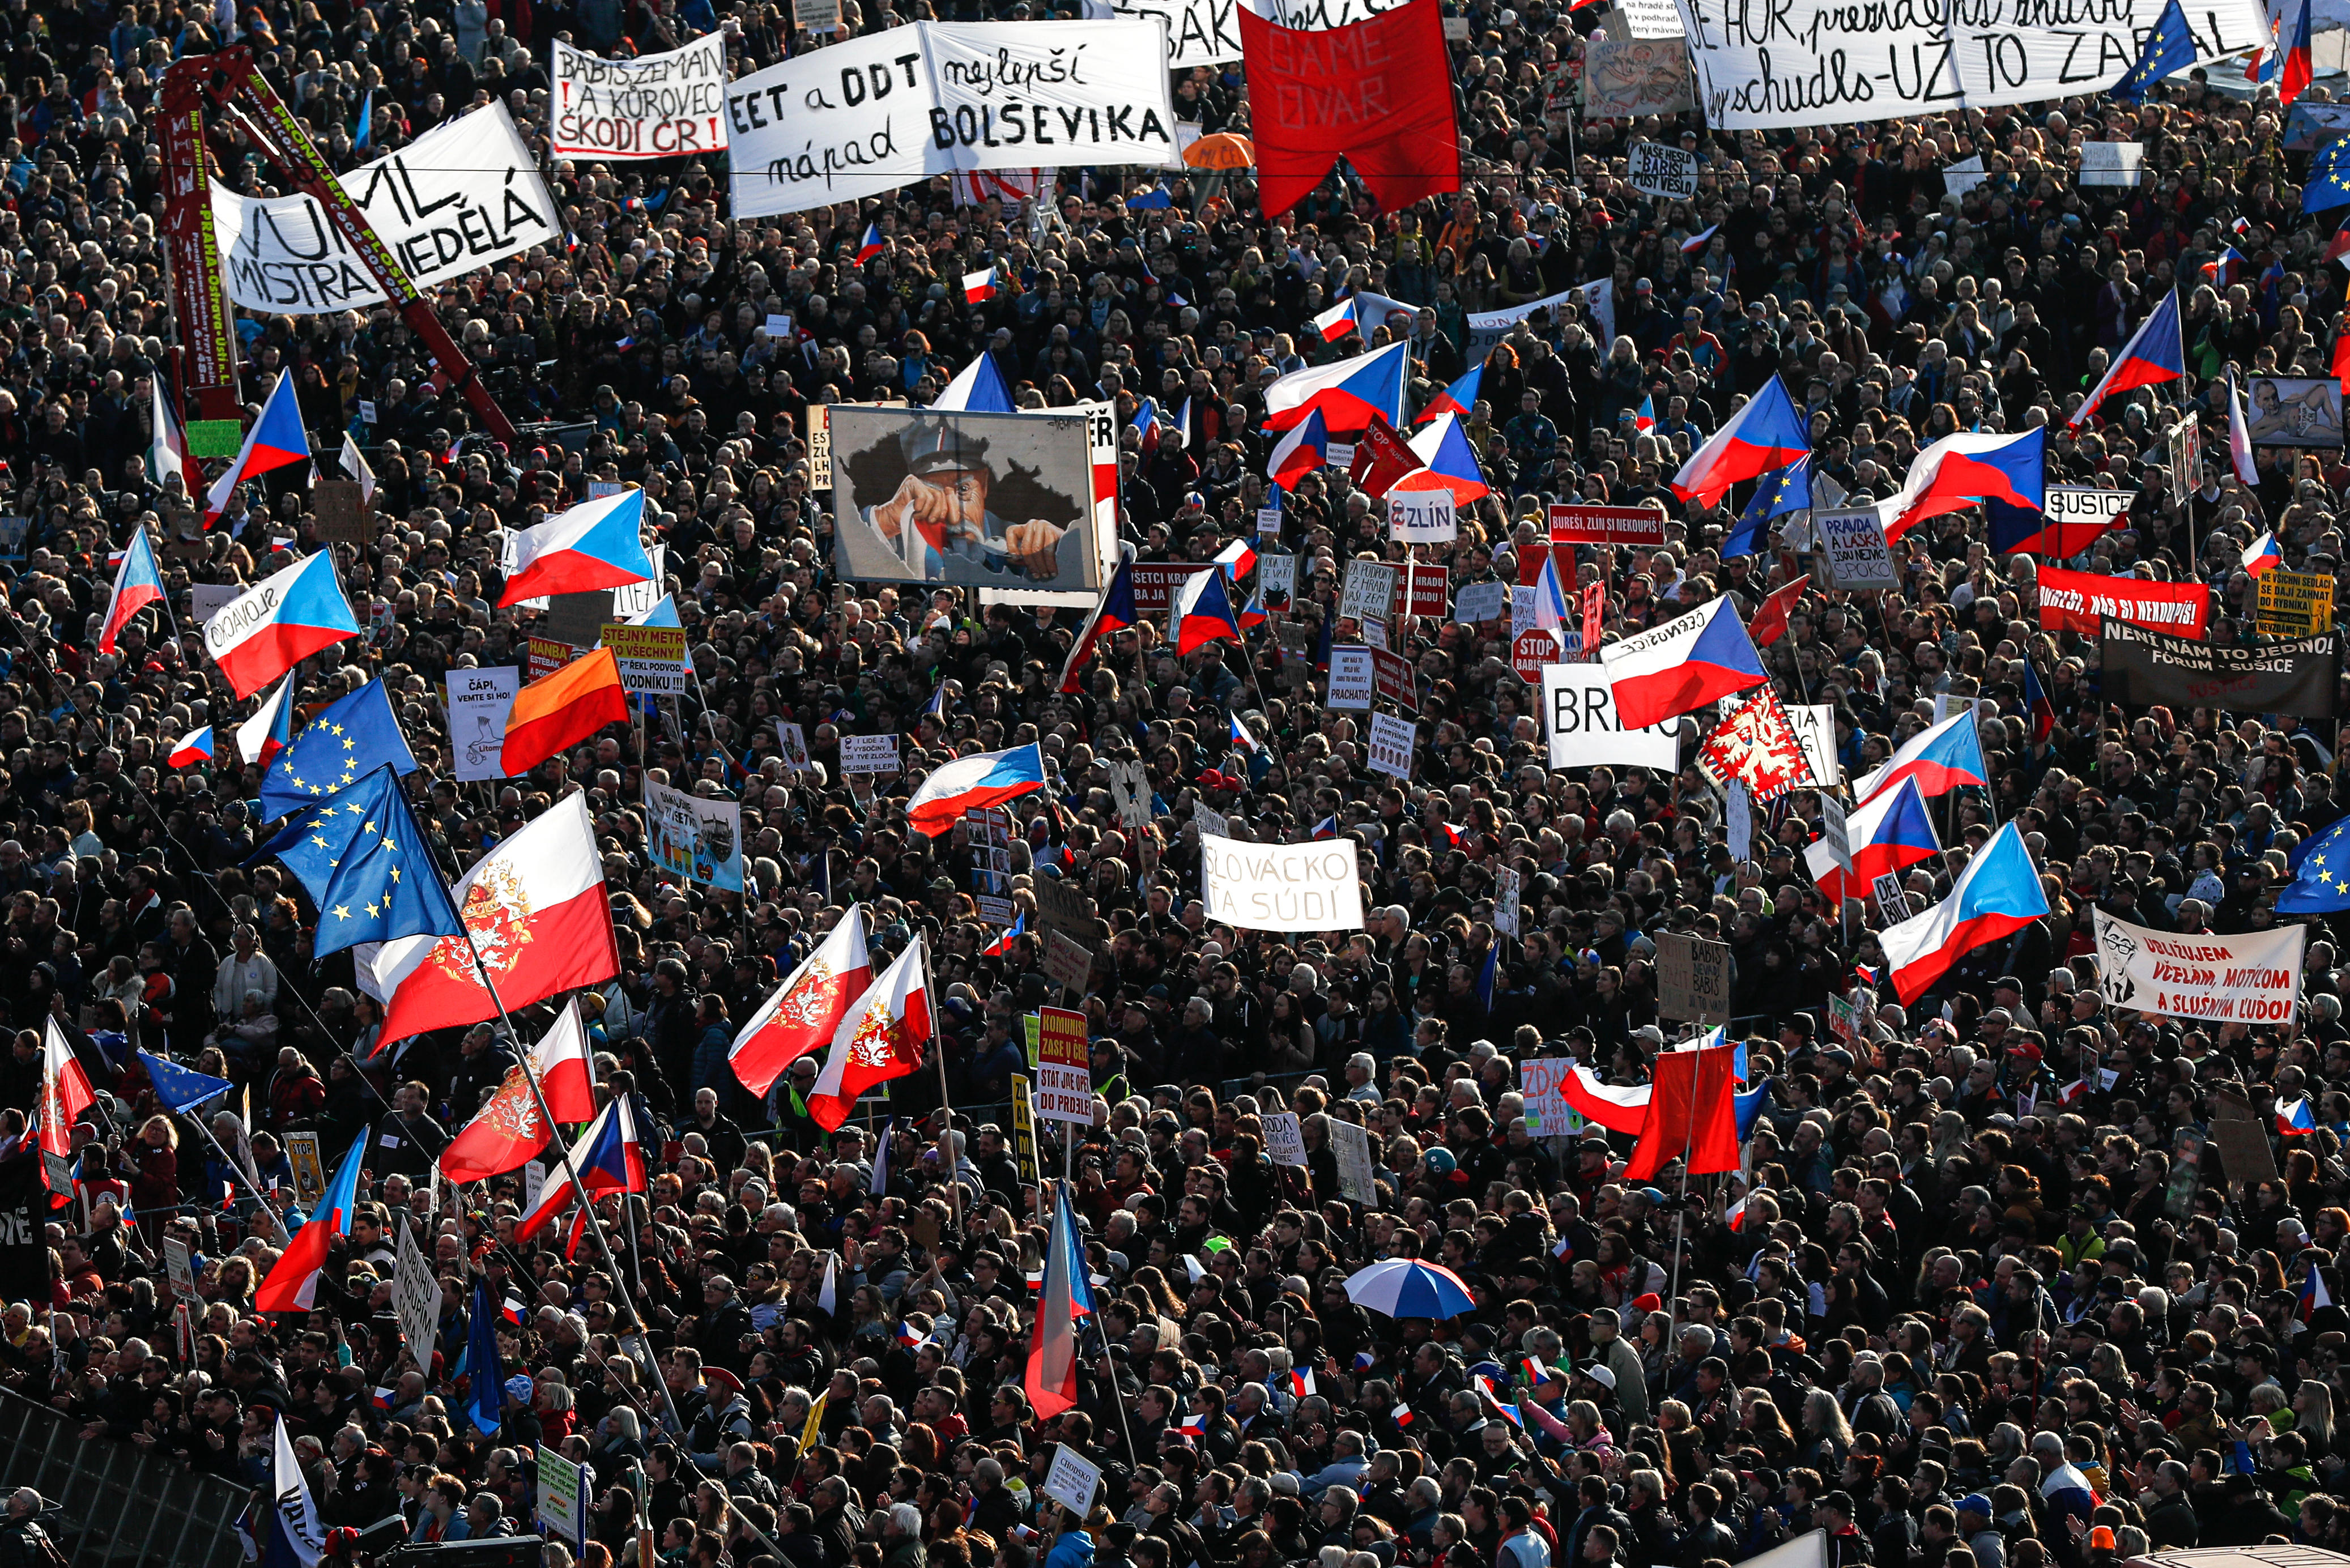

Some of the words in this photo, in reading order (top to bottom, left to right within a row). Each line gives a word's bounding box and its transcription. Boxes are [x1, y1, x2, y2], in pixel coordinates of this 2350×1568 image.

[1641, 12, 1679, 24] podhradí
[944, 42, 1088, 95] nejlepší
[1973, 33, 2028, 93] TO
[577, 90, 599, 113] A
[611, 81, 723, 119] KŮROVEC
[727, 83, 788, 134] EET
[804, 88, 836, 110] a
[841, 52, 921, 107] DDT
[929, 95, 1171, 150] BOLŠEVIKA
[768, 114, 902, 191] nápad
[1639, 144, 1663, 157] NAŠE
[1666, 148, 1691, 164] HESLO
[1661, 178, 1691, 195] VESLO
[229, 256, 377, 308] MISTRA
[1368, 424, 1389, 446] STOP
[1407, 501, 1451, 528] ZLÍN
[1552, 513, 1585, 531] BUREŠI,
[1587, 514, 1605, 530] ZLÍN
[1607, 518, 1615, 531] SI
[1616, 517, 1657, 533] NEKOUPÍŠ
[1826, 518, 1874, 535] PRAVDA
[1832, 536, 1841, 549] A
[1844, 531, 1883, 548] LÁSKA
[1262, 557, 1278, 568] VODA
[1283, 557, 1293, 568] UŽ
[1834, 551, 1853, 562] JSOU
[1855, 547, 1886, 561] NEJVÍC
[1131, 570, 1164, 584] ŠETCI
[1262, 569, 1270, 578] SE
[1348, 562, 1358, 576] ZA
[1360, 566, 1394, 579] PODPORY
[1834, 562, 1891, 580] SPOKO
[1350, 576, 1359, 589] Z
[1361, 578, 1391, 593] HRADU
[1416, 576, 1444, 587] HRADU
[2262, 573, 2271, 582] NE
[2273, 573, 2300, 585] VŠICHNI
[2302, 577, 2331, 589] SEDLÁCI
[1364, 593, 1385, 604] ZEM
[2260, 585, 2272, 594] SE
[2274, 586, 2294, 596] DAJÍ
[2297, 589, 2330, 600] ZAHNAT
[2090, 594, 2117, 617] NÁS
[2119, 600, 2135, 621] SI
[2137, 599, 2197, 625] NEKOUPÍŠ!
[2260, 596, 2271, 606] DO
[2274, 598, 2308, 611] RYBNÍKA
[603, 627, 648, 642] STEJNÝ
[650, 632, 684, 645] METR
[2258, 622, 2296, 635] NEVZDÁME
[2298, 627, 2309, 636] TO!
[529, 639, 567, 660] HANBA
[1520, 638, 1554, 656] STOP
[2105, 622, 2160, 648] NENÍ
[2164, 638, 2213, 659] NÁM
[2216, 648, 2249, 661] TO
[2255, 636, 2334, 658] JEDNO!
[627, 644, 674, 658] VŠECHNY
[630, 661, 648, 670] ŘEKL
[649, 663, 683, 672] PODVOD.
[2152, 649, 2213, 672] FÓRUM
[2230, 658, 2293, 674] SUŠICE
[469, 679, 497, 691] ČÁPI,
[2187, 675, 2258, 700] JUSTICE
[457, 693, 484, 702] VEMTE
[1331, 689, 1369, 700] PRACHATIC
[1206, 846, 1348, 882] SLOVÁCKO
[1252, 885, 1339, 922] SÚDÍ
[2152, 960, 2216, 989] VČELÁM,
[2157, 992, 2167, 1011] A
[2173, 992, 2234, 1017] SLUŠNÝM
[1042, 1038, 1063, 1058] ZASE
[1066, 1042, 1071, 1058] V
[1041, 1067, 1059, 1088] STÁT
[1041, 1093, 1054, 1109] DO
[1538, 1099, 1546, 1115] U
[1544, 1117, 1565, 1134] PAKY
[292, 1143, 312, 1154] STOP
[404, 1234, 433, 1303] KOBLIHU
[398, 1256, 405, 1277] SI
[404, 1273, 432, 1337] KOUPÍM
[398, 1294, 415, 1347] SAMA
[1061, 1458, 1091, 1482] CHODSKO
